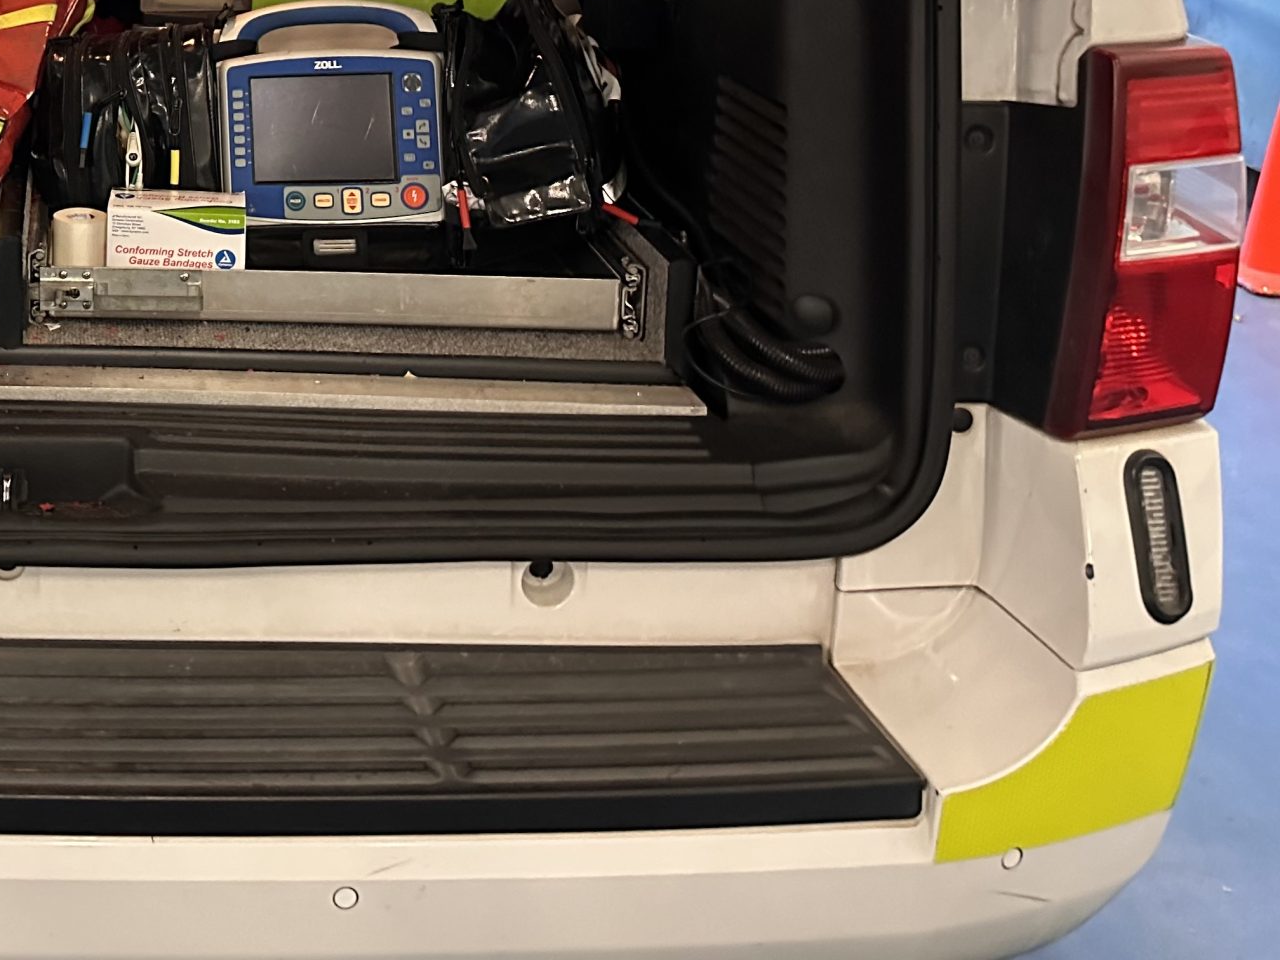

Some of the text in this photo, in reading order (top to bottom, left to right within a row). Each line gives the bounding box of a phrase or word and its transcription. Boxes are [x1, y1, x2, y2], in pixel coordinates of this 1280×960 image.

[313, 59, 343, 70] ZOLL
[115, 244, 214, 258] Conforming Stretch
[128, 255, 161, 266] Gauze
[162, 257, 214, 269] Bandages
